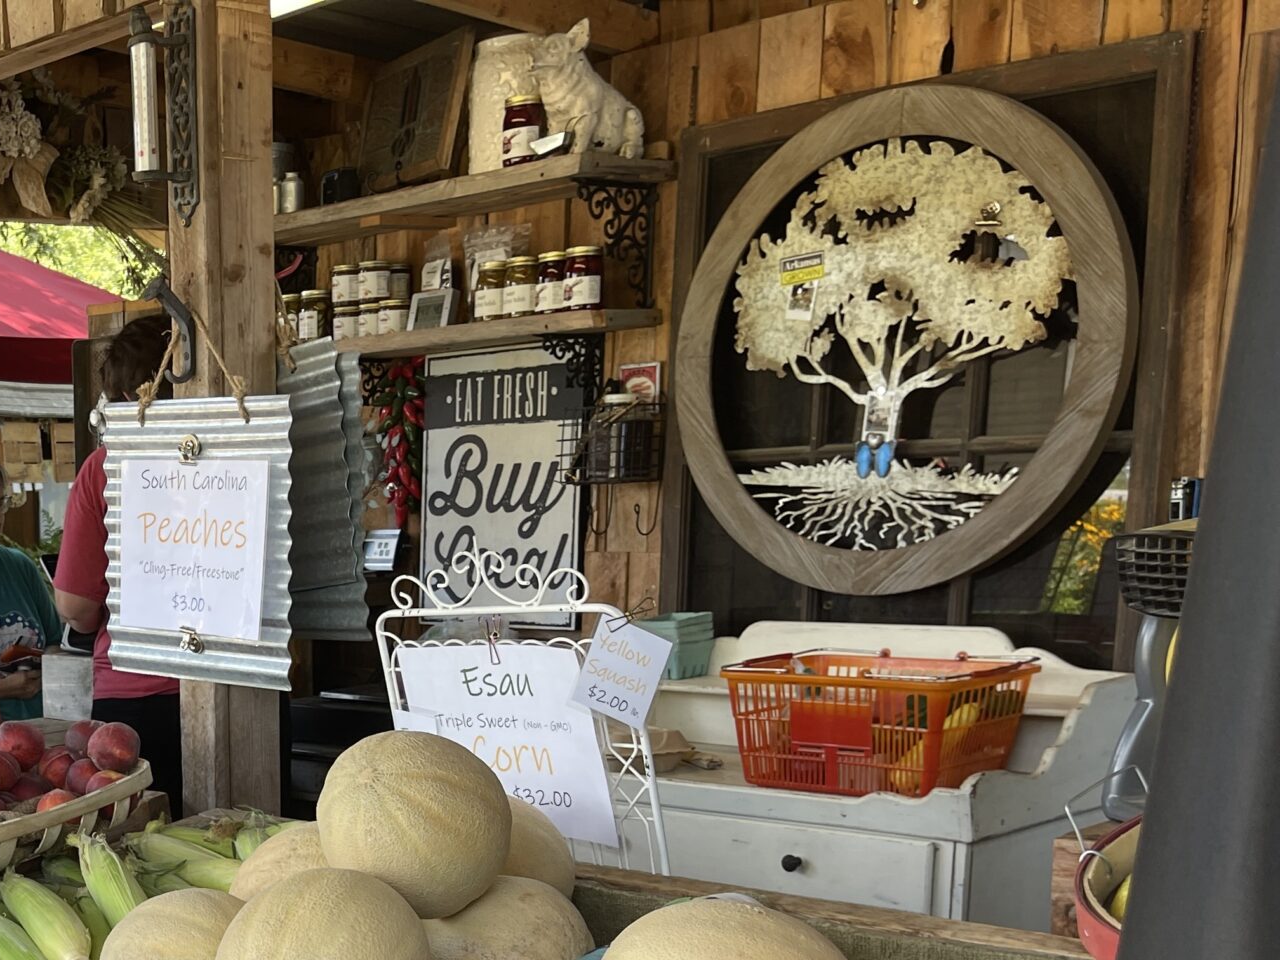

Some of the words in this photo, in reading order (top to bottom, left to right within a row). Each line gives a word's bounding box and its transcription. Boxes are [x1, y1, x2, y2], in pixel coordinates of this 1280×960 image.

[455, 376, 485, 423] EAT
[493, 371, 548, 420] FRESH
[141, 469, 187, 490] South
[192, 470, 248, 491] Carolina
[428, 434, 567, 539] Buy
[137, 510, 247, 548] Peaches
[171, 592, 205, 612] $3.00
[600, 634, 651, 667] Yellow
[461, 666, 534, 698] Esau
[587, 659, 647, 696] Squash
[588, 684, 629, 712] $2.00
[435, 713, 474, 733] Triple
[476, 713, 518, 729] Sweet
[472, 735, 554, 775] Corn
